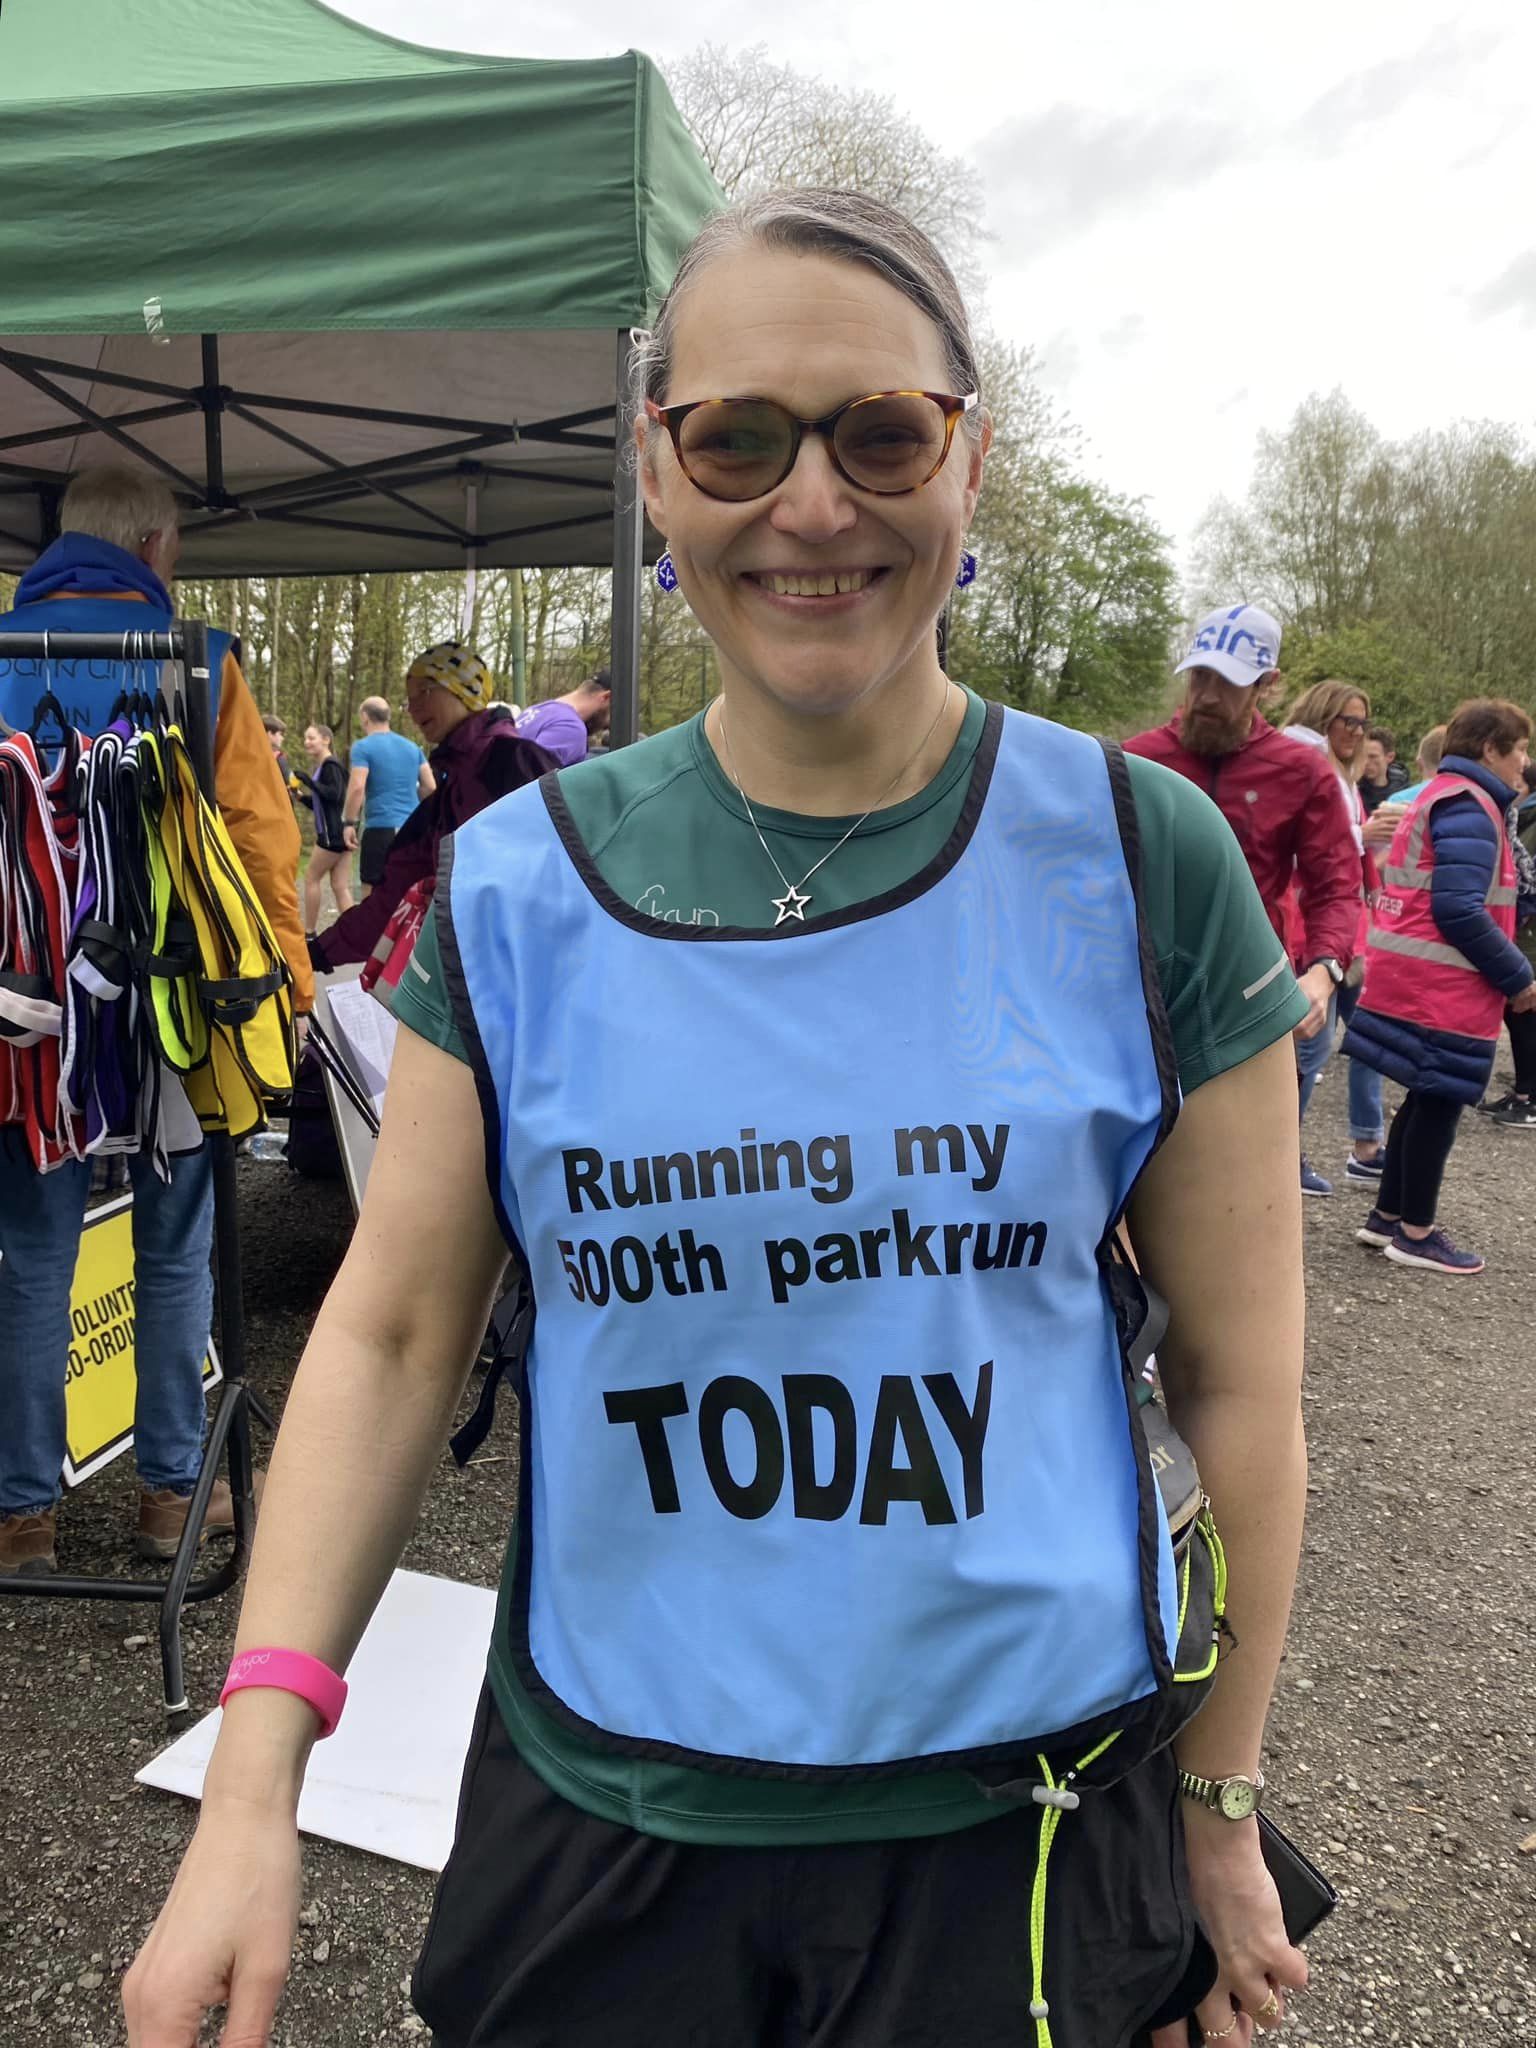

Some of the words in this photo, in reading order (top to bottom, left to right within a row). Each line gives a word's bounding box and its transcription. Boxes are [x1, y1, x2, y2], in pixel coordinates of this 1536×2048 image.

[562, 1128, 854, 1213] Running
[894, 1123, 1010, 1192] my
[558, 1229, 728, 1307] 500th
[764, 1209, 1048, 1304] parkrun
[71, 1280, 135, 1341] OLUNT
[603, 1360, 994, 1526] TODAY
